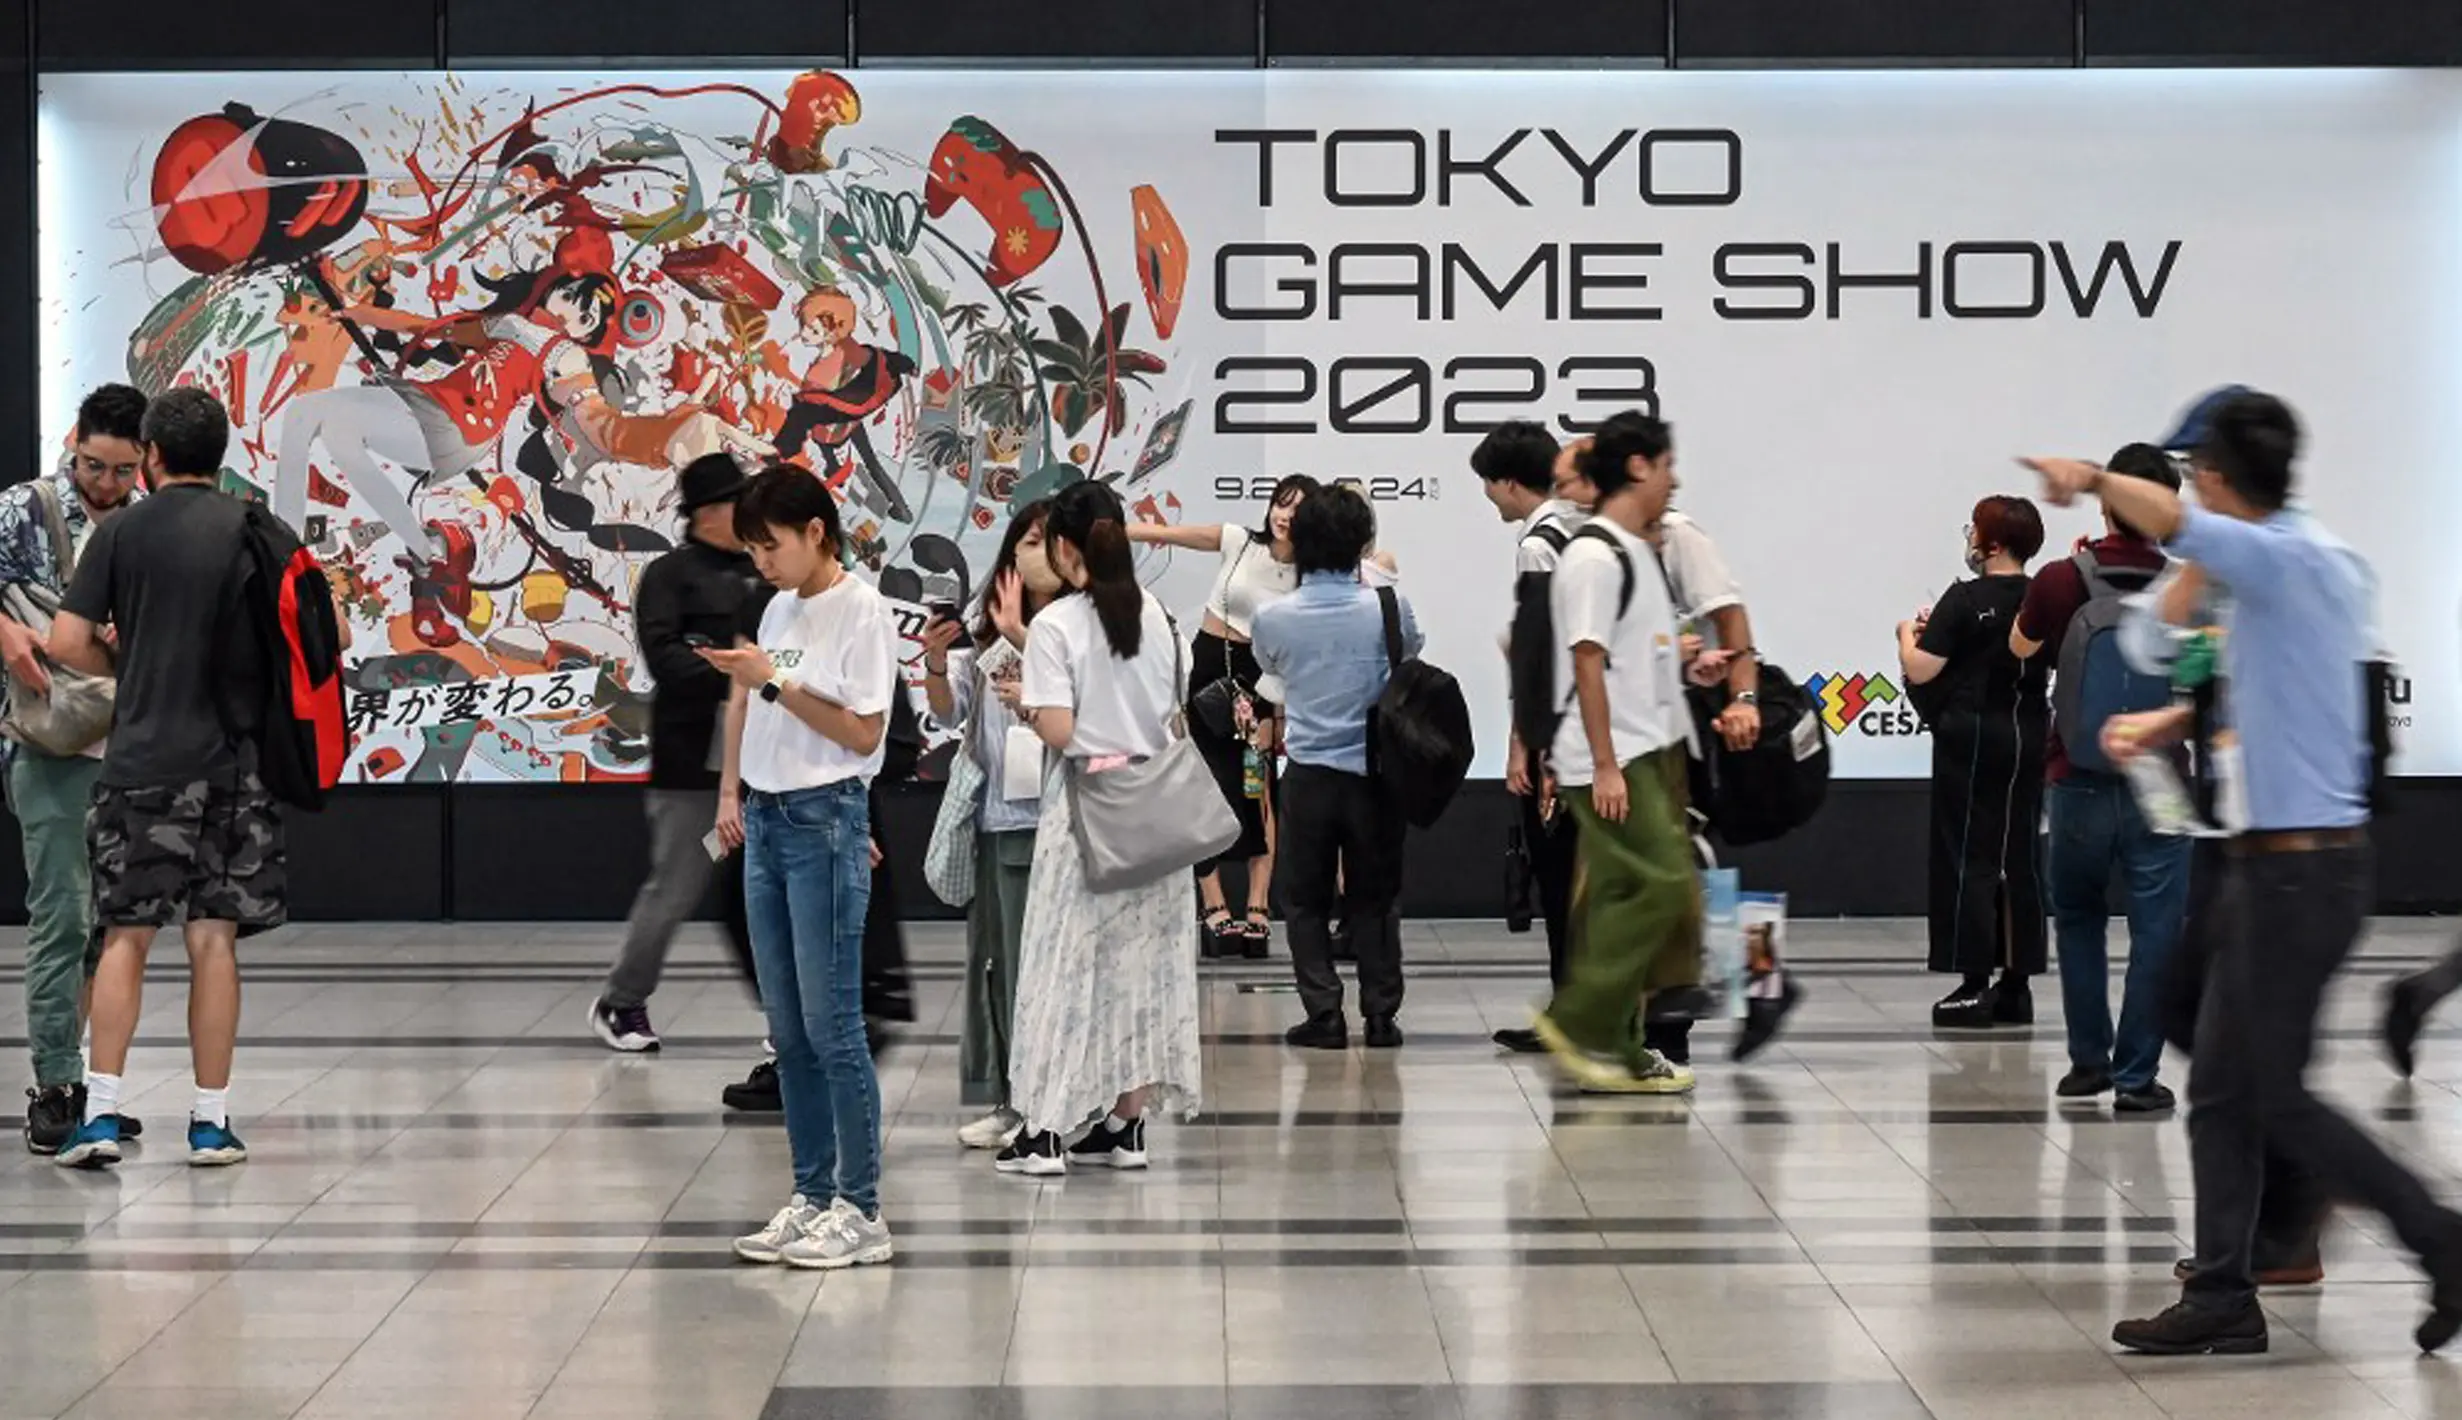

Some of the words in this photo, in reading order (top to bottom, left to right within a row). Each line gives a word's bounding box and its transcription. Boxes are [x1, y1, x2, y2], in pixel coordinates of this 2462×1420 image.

[1214, 129, 1742, 207] TOKYO
[1214, 242, 1663, 320] GAME
[1713, 240, 2183, 320] SHOW
[1214, 356, 1660, 434] 2023
